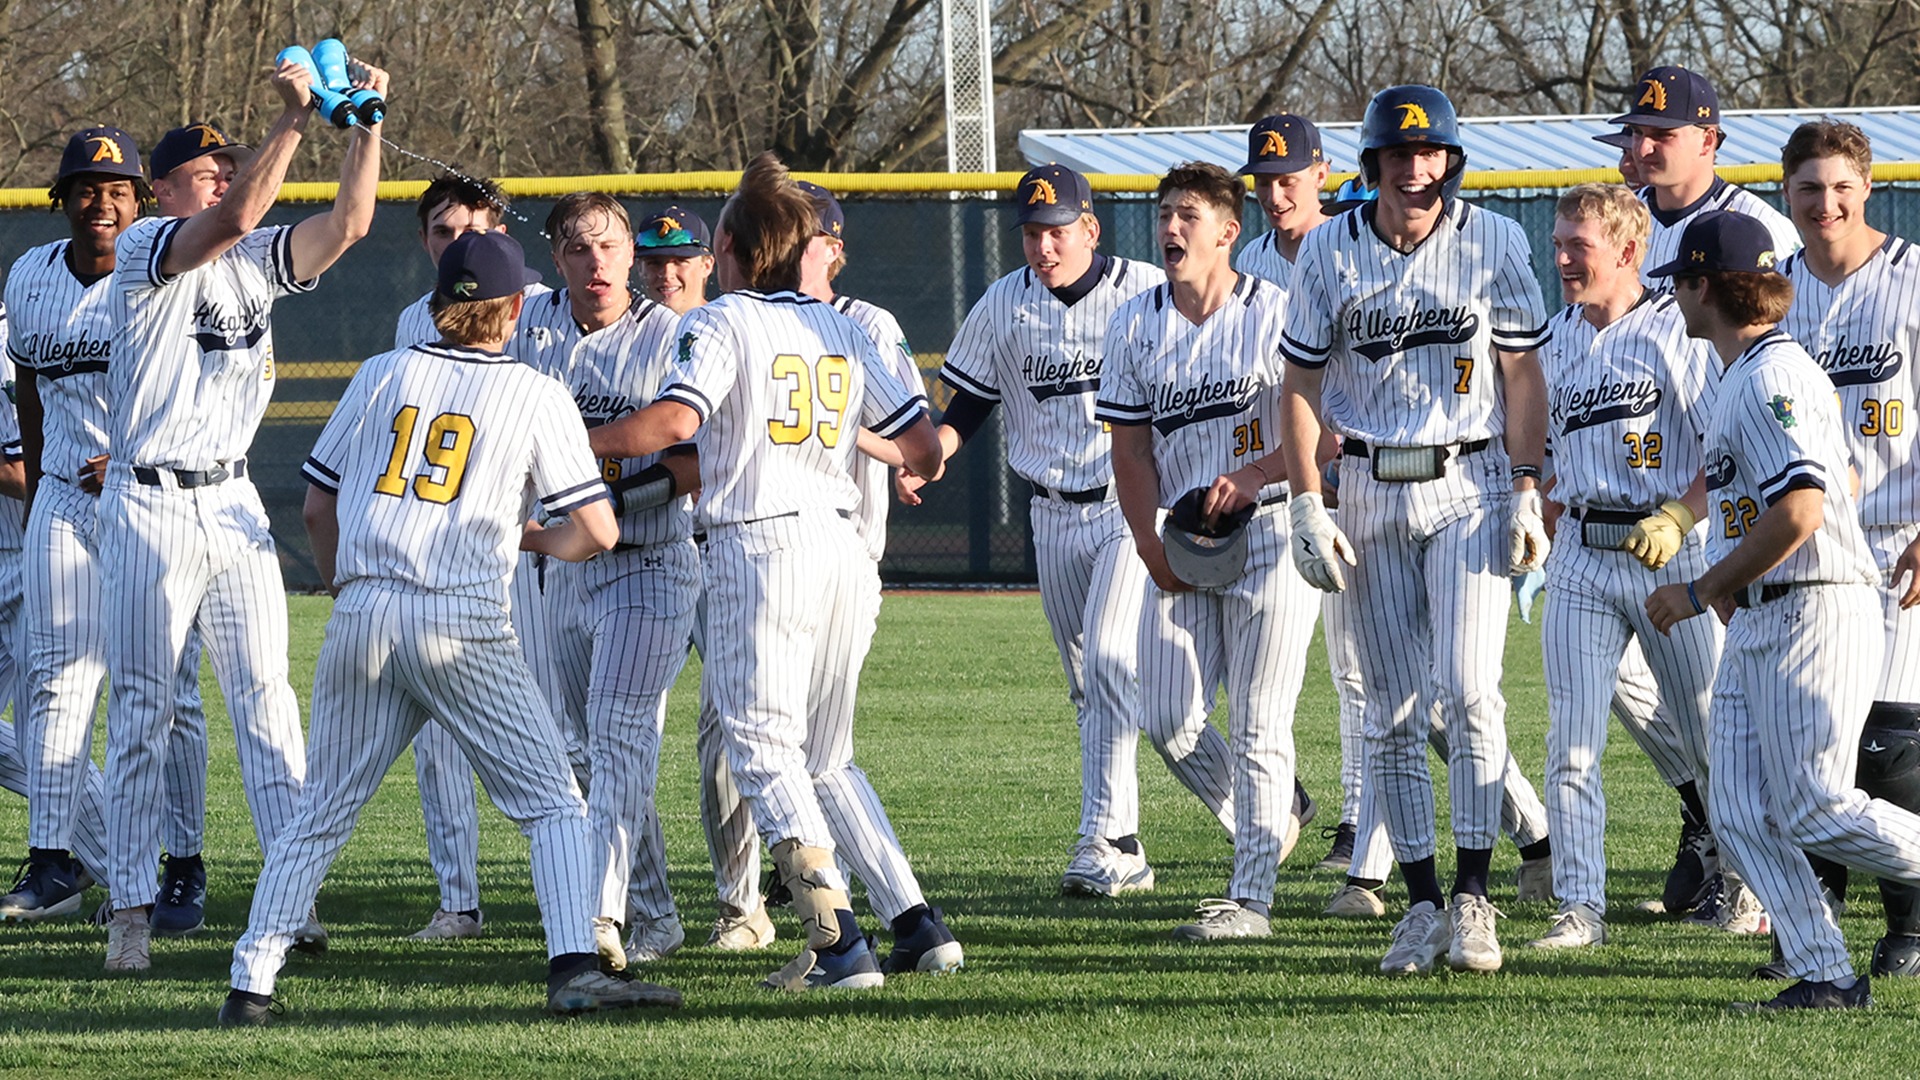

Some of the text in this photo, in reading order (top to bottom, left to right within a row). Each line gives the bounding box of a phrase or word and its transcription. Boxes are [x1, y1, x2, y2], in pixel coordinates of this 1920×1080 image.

[1393, 103, 1431, 130] A
[1347, 299, 1468, 346] Allegheny
[1148, 372, 1255, 418] Allegheny
[1454, 356, 1474, 394] 7
[768, 353, 850, 449] 39
[1551, 373, 1653, 426] Allegheny
[1860, 397, 1904, 437] 30
[373, 404, 477, 506] 19
[1233, 418, 1264, 458] 31
[1622, 431, 1663, 470] 32
[1720, 496, 1760, 540] 22
